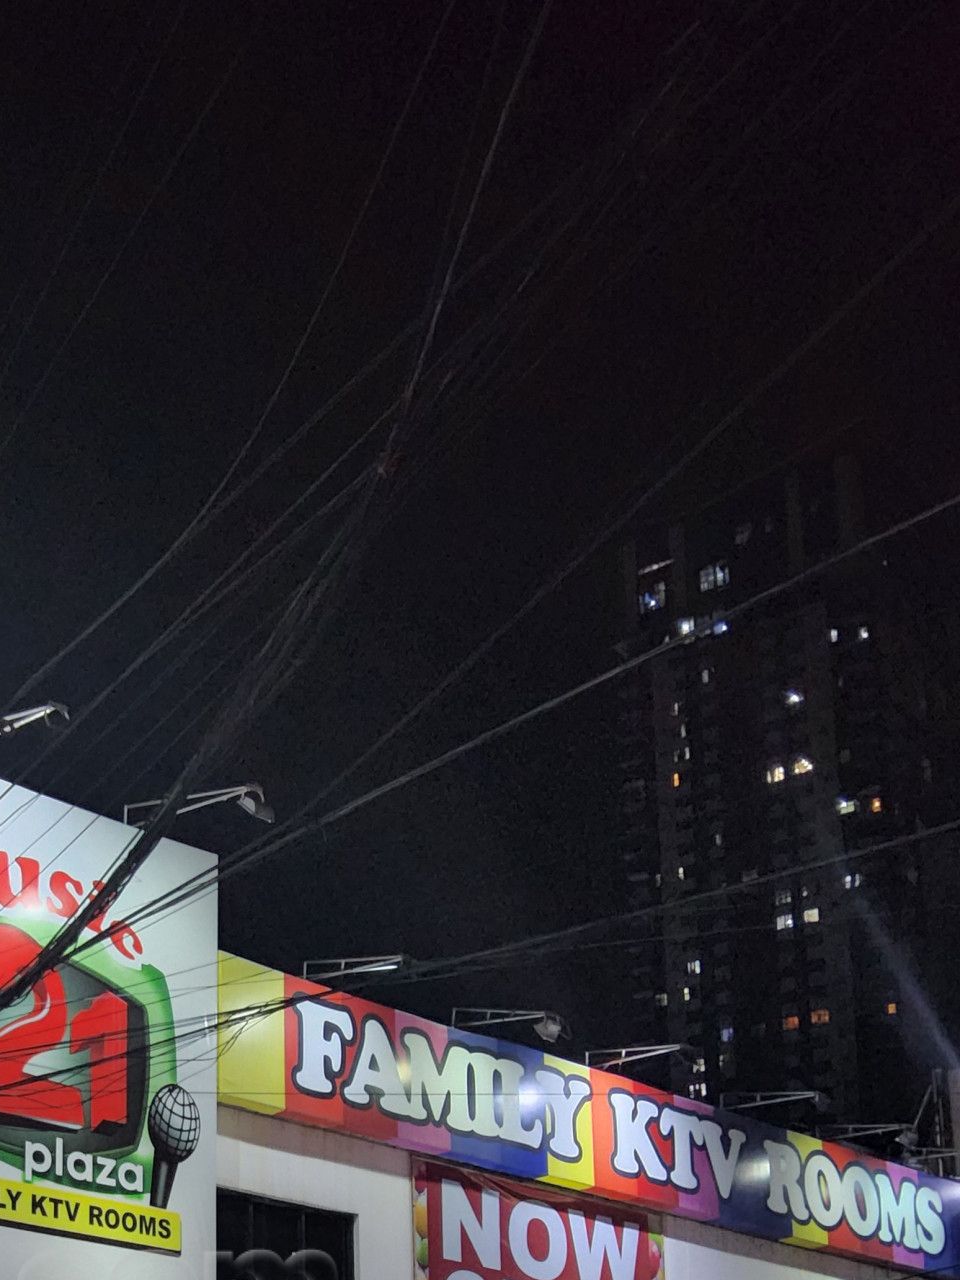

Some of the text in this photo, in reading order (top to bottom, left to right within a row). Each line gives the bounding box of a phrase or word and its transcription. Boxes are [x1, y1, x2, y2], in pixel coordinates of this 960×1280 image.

[291, 992, 947, 1256] FAMILY KTV ROOMS
[24, 1138, 144, 1194] plaza
[31, 1184, 80, 1222] KTV
[88, 1204, 172, 1241] ROOMS
